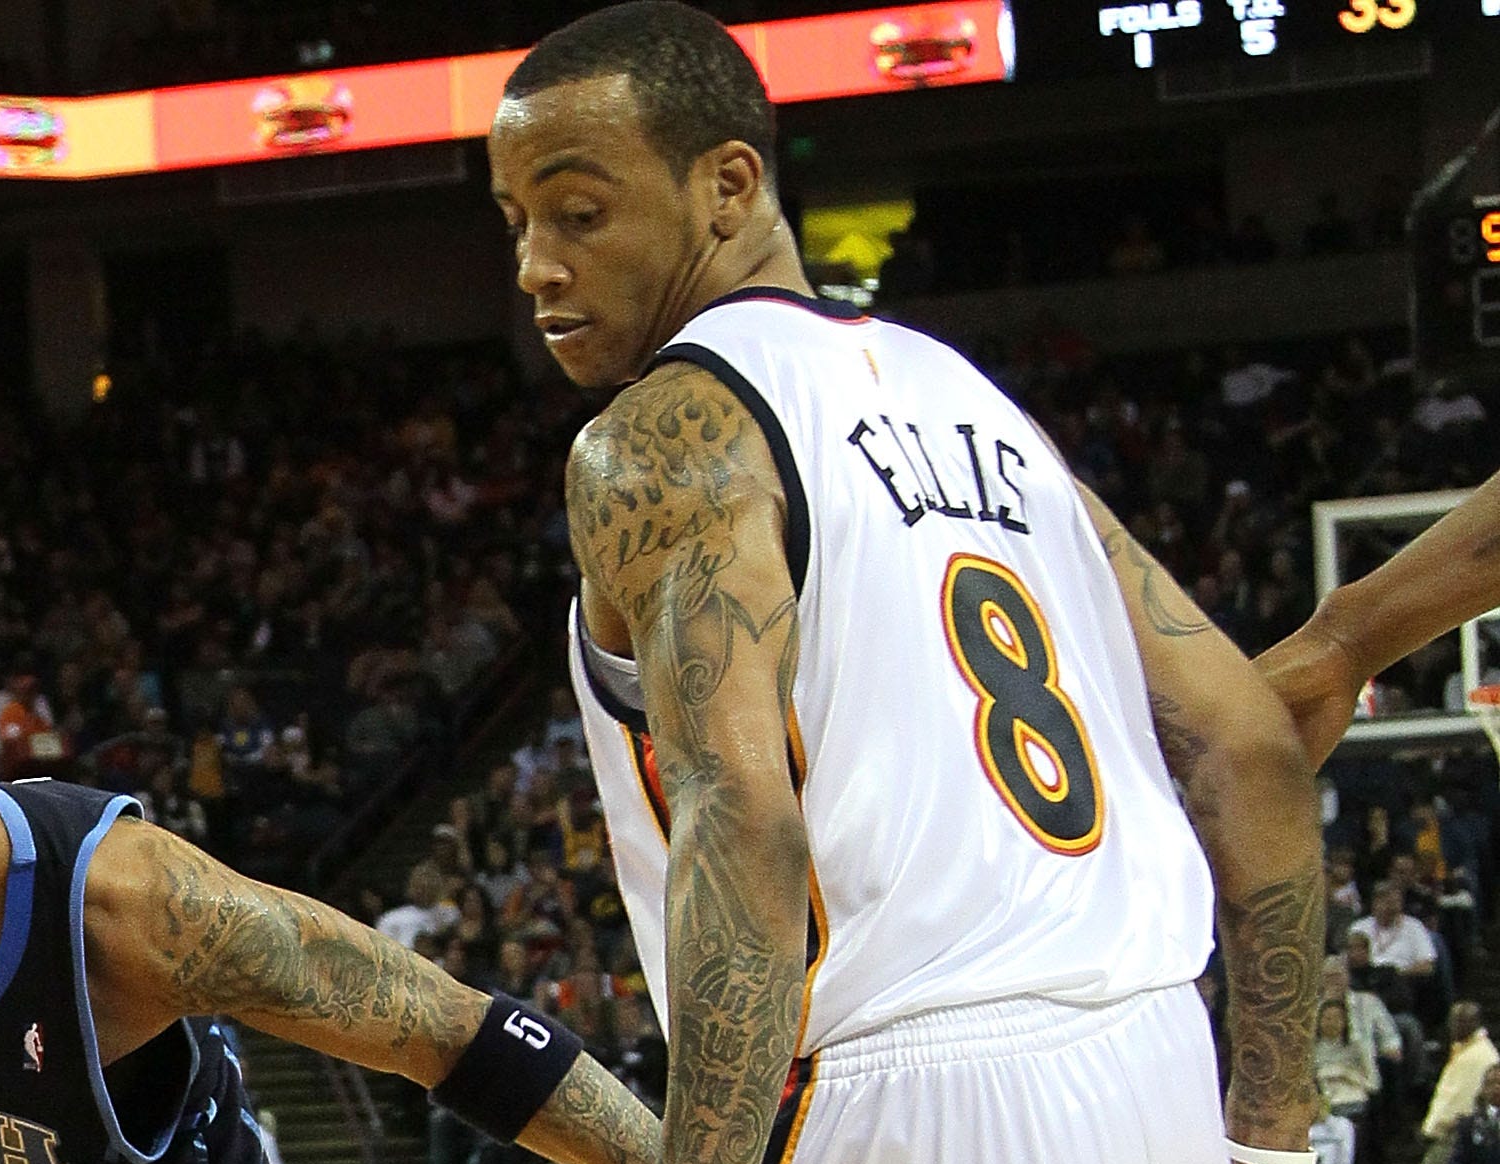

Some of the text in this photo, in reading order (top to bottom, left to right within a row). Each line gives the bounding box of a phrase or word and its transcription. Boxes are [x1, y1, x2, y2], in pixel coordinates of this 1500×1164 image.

[1099, 0, 1202, 36] FOULS
[1240, 19, 1276, 55] 5
[1134, 32, 1152, 68] 1
[847, 414, 1031, 535] ELLIS
[940, 552, 1105, 857] 8
[503, 1010, 551, 1050] 5
